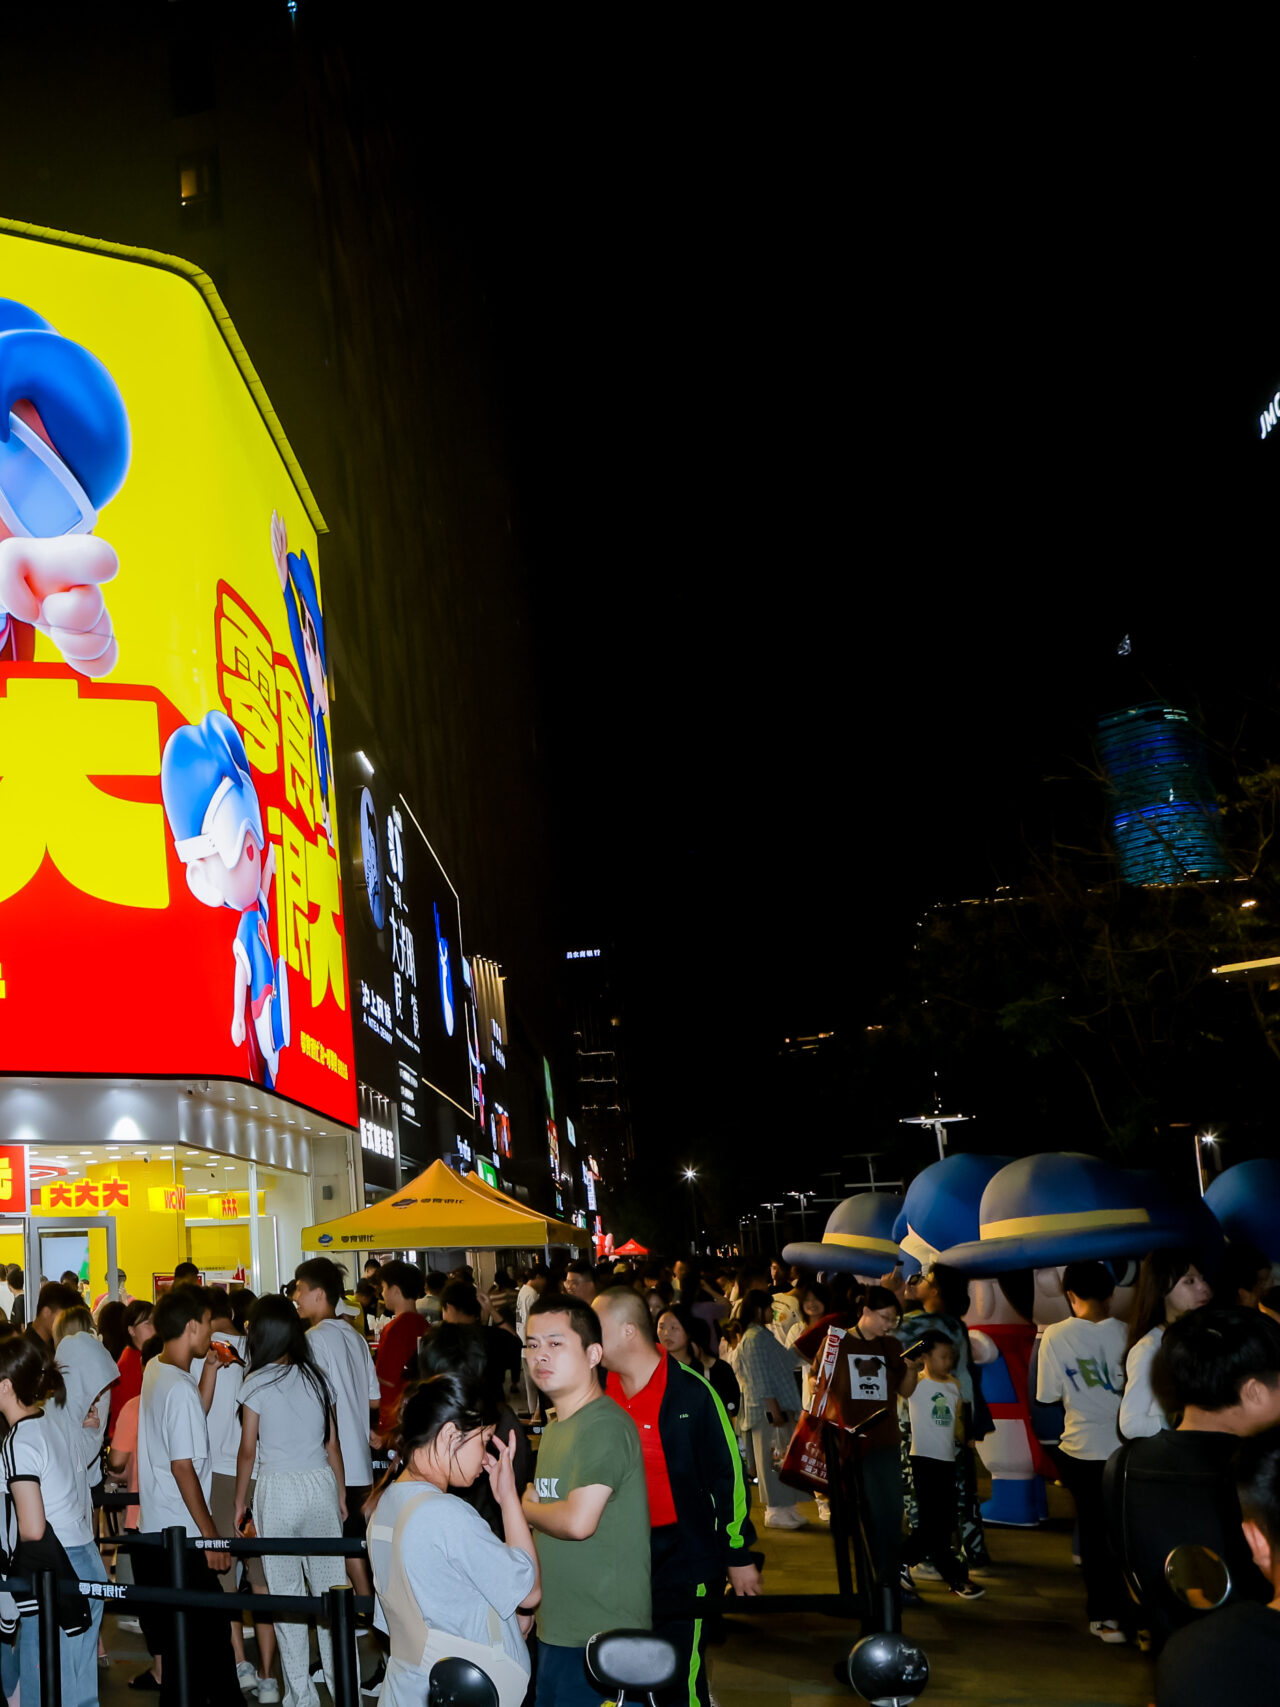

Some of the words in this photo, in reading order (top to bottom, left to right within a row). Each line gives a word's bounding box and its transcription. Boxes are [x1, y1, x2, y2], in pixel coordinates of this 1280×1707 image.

[50, 1178, 129, 1208] 大大大
[195, 1539, 231, 1550] 零食很忙
[78, 1582, 127, 1599] 零食很忙
